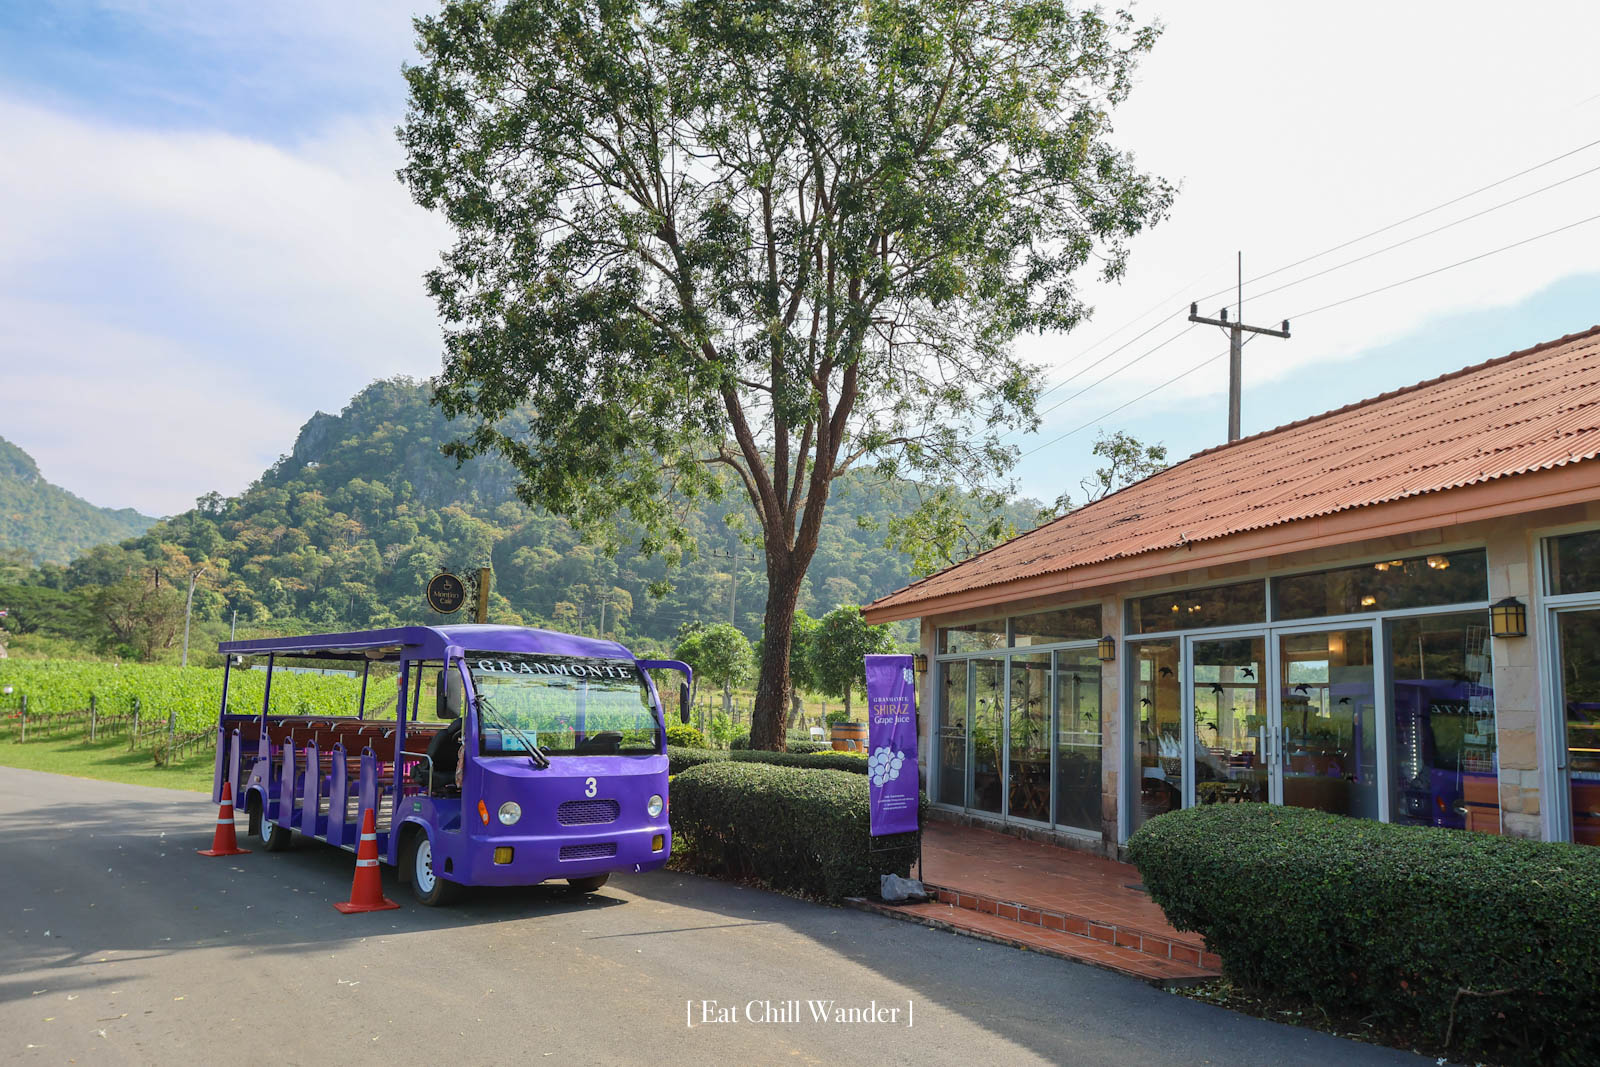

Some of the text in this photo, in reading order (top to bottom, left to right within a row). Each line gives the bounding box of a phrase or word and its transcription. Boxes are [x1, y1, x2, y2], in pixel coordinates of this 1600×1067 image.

[478, 659, 632, 679] GRANMONTE
[873, 703, 909, 716] SHIRAZ
[585, 777, 597, 798] 3
